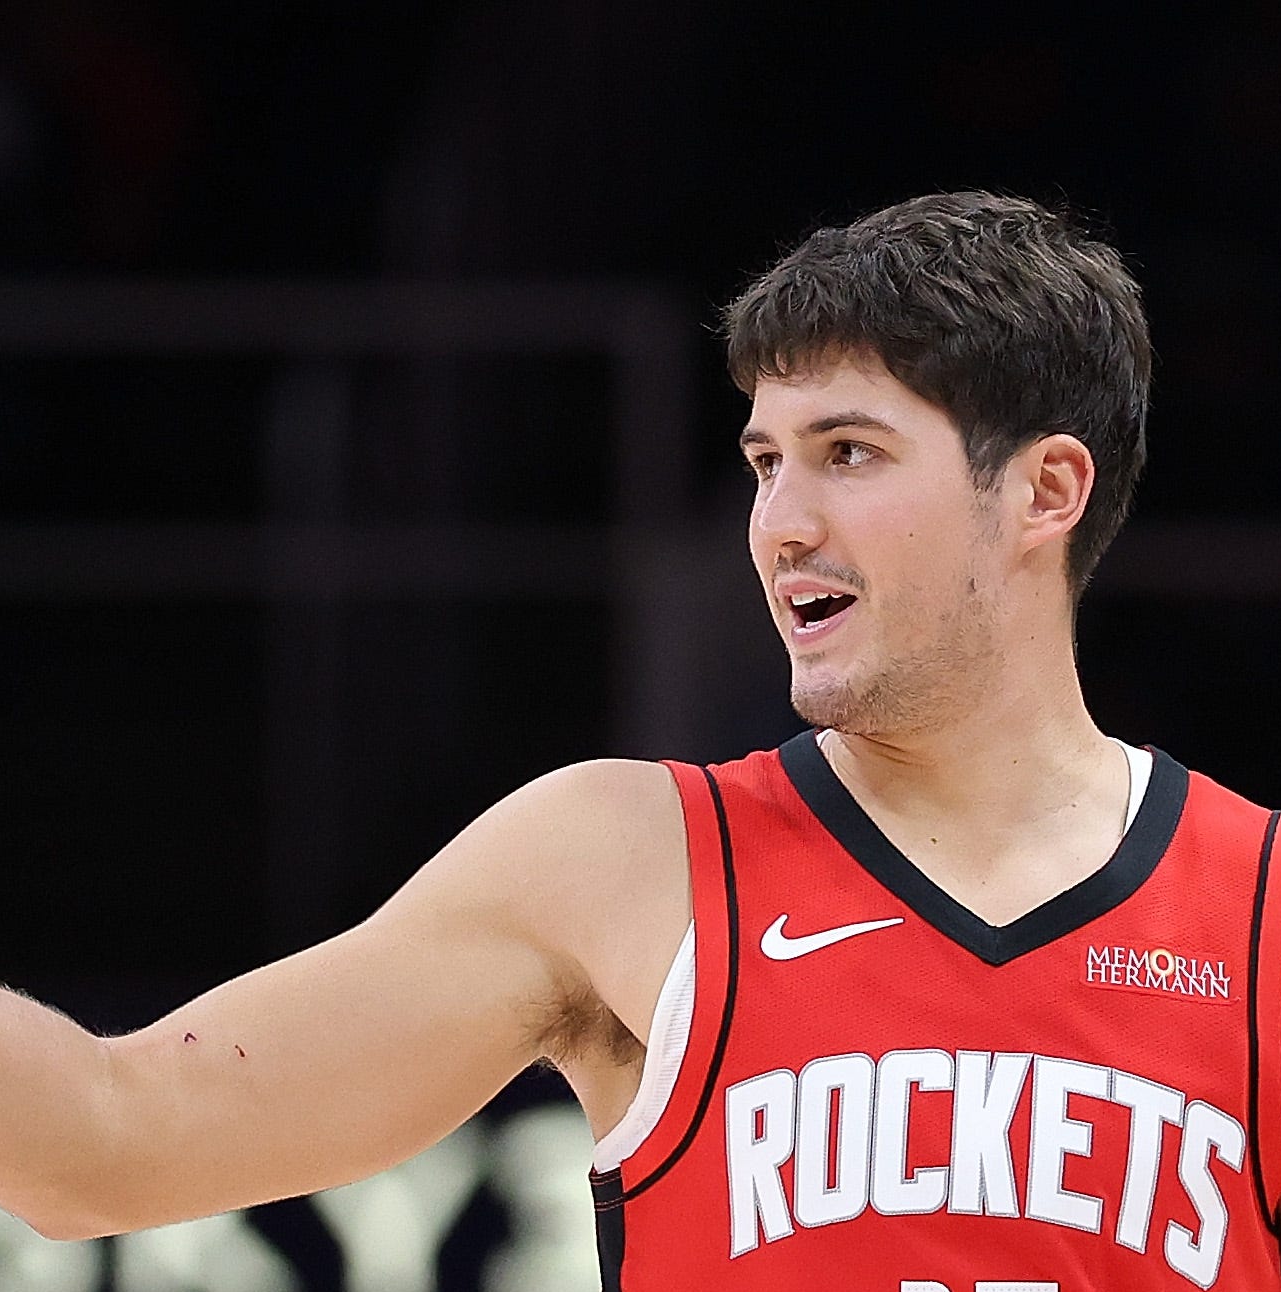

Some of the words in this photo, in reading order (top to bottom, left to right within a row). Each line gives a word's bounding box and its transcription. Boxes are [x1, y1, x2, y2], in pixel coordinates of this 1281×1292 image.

[1086, 945, 1231, 981] MEMORIAL
[1086, 960, 1231, 998] HERMANN
[726, 1050, 1244, 1290] ROCKETS
